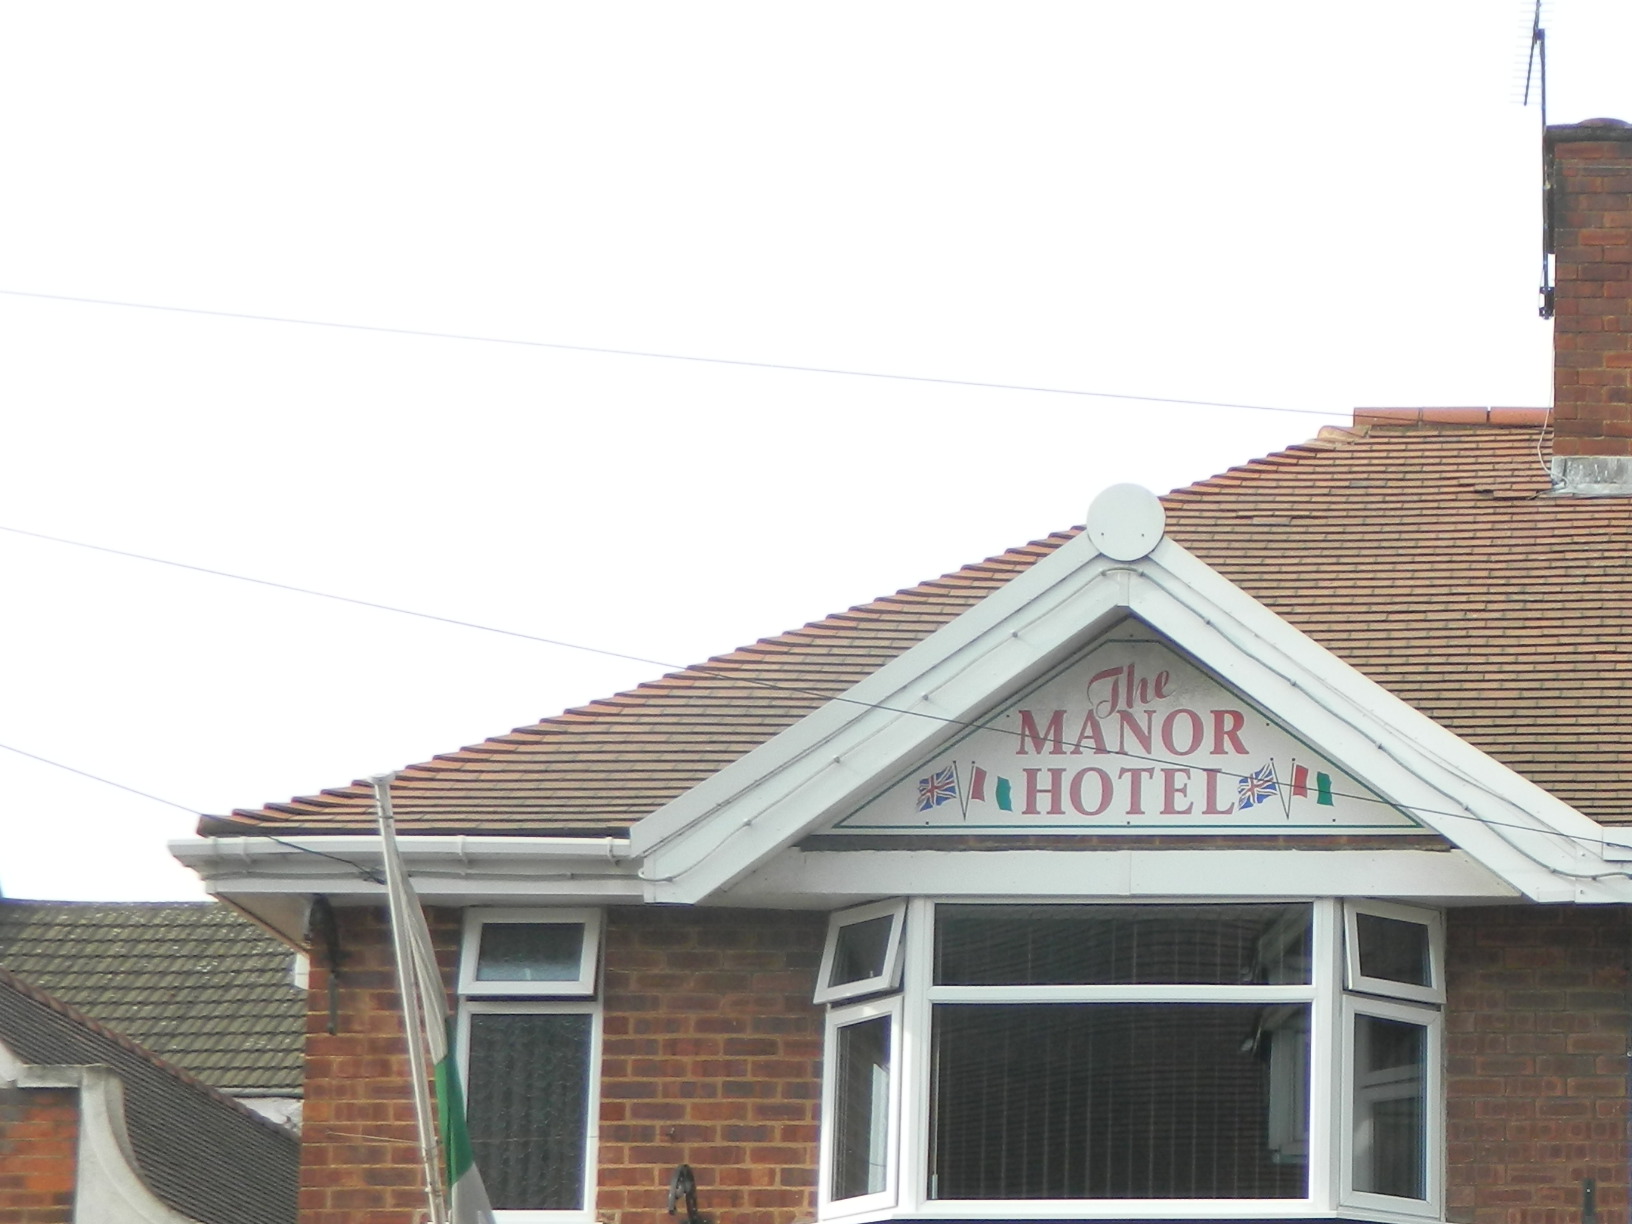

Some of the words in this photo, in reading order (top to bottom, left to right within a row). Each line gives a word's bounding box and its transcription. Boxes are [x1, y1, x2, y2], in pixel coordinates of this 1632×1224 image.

[1087, 663, 1178, 720] The
[1015, 708, 1250, 757] MANOR
[1021, 766, 1237, 817] HOTEL
